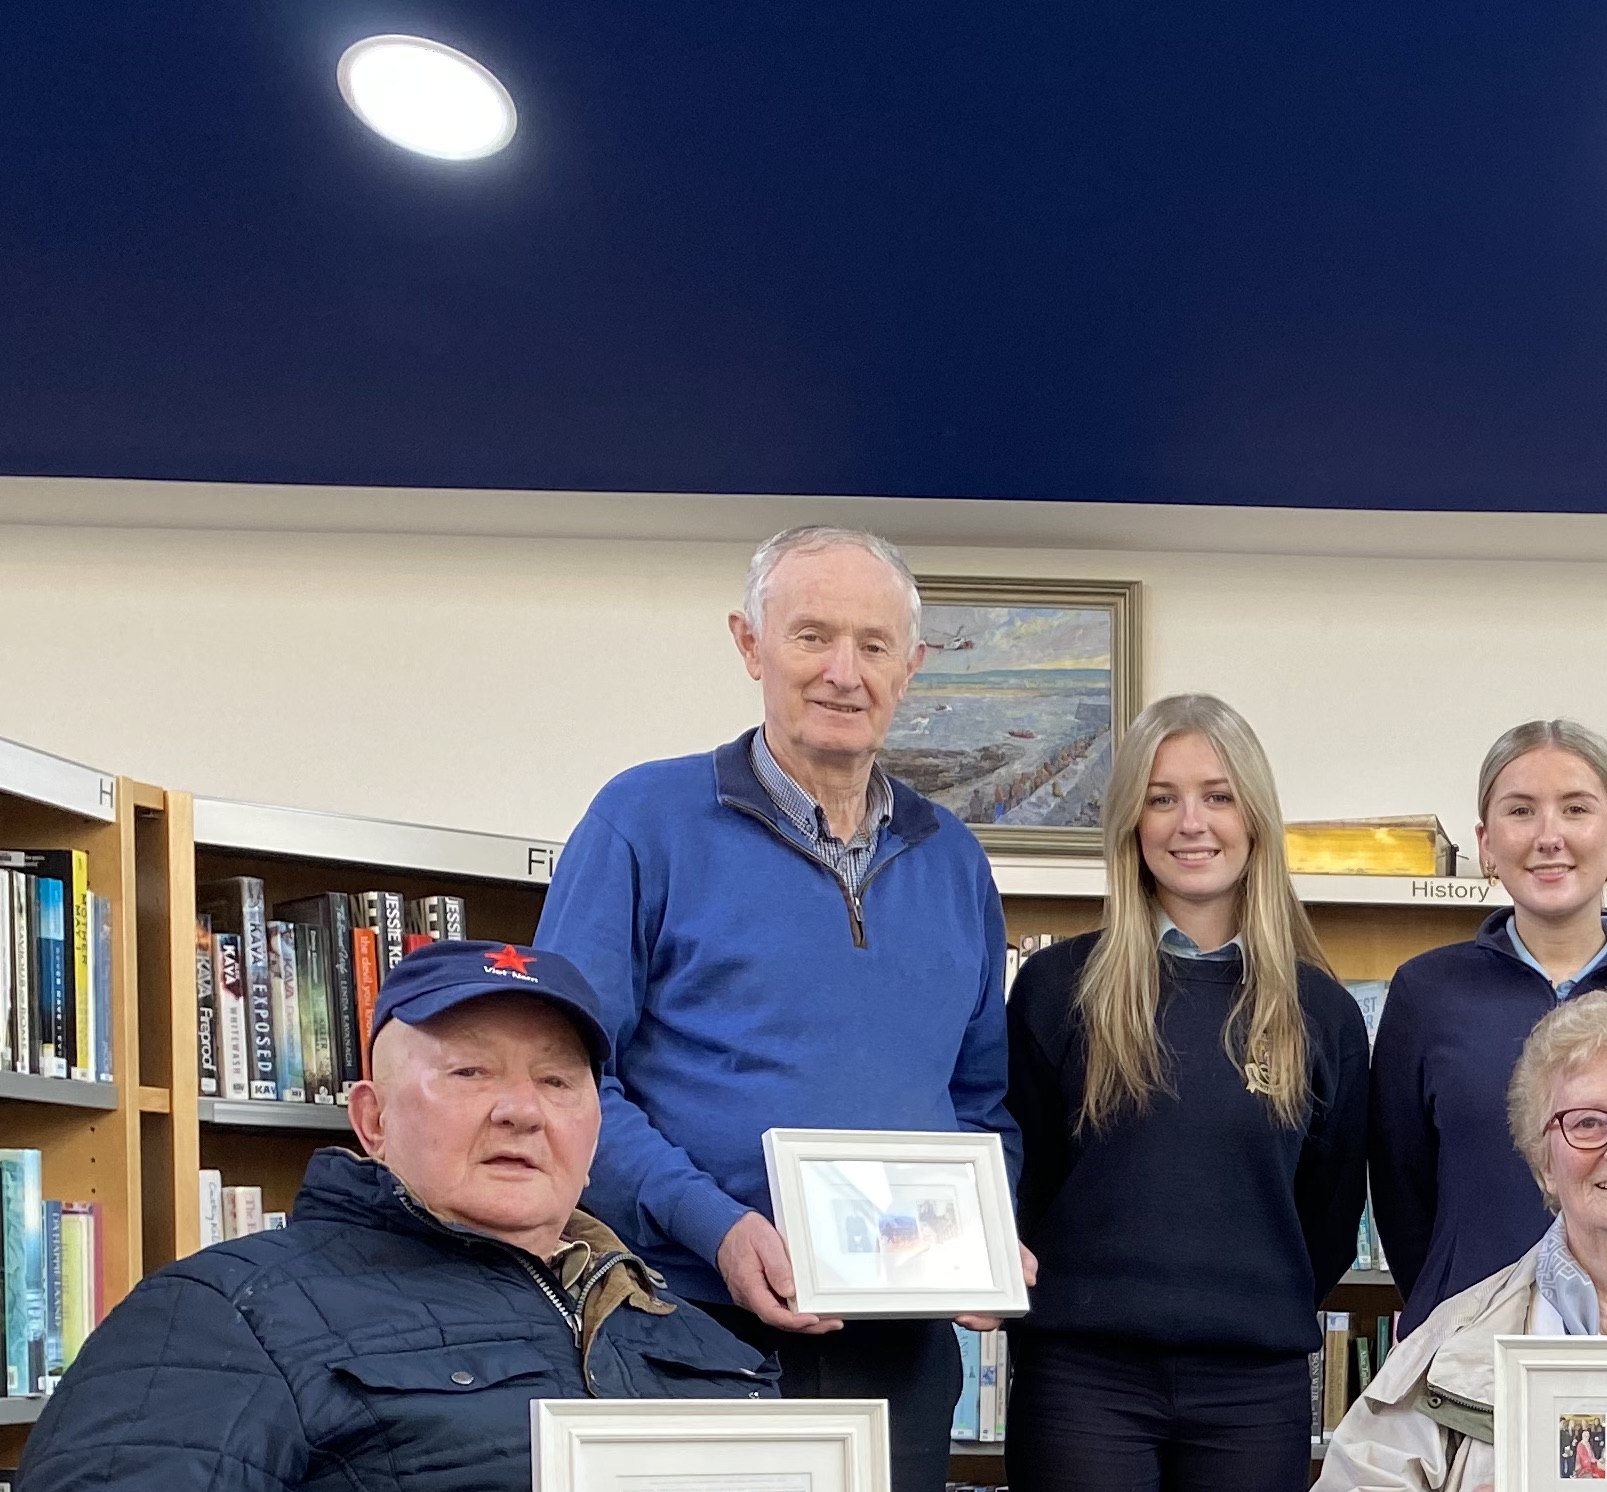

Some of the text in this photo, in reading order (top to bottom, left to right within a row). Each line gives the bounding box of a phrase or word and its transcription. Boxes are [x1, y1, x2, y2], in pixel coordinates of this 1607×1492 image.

[100, 779, 113, 807] H
[1412, 880, 1490, 902] History
[385, 893, 402, 943] JESSIE
[361, 936, 370, 954] the
[284, 958, 294, 1000] KAVA
[362, 957, 373, 983] devil
[223, 944, 240, 1074] KAVA WHITEWASH
[249, 922, 272, 1072] KAVA EXPOSED
[363, 985, 372, 1005] you
[199, 1007, 216, 1072] Fireproof
